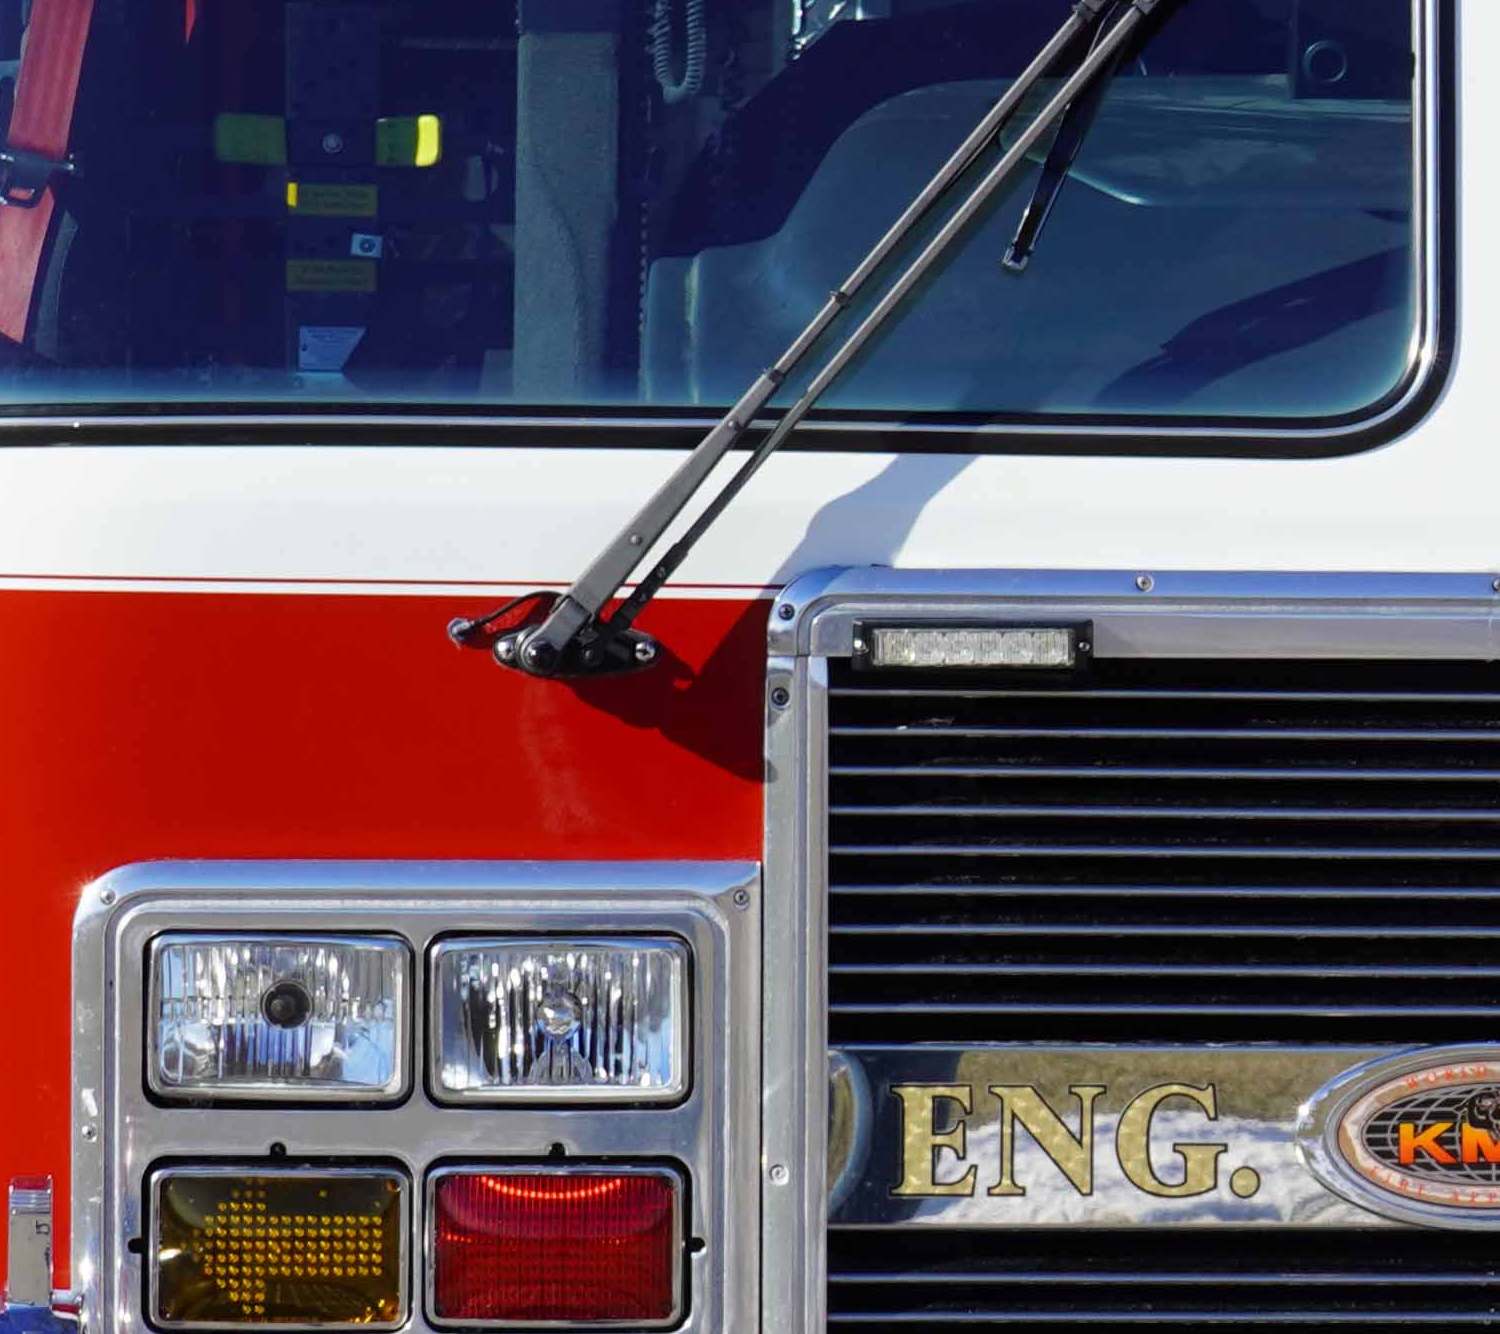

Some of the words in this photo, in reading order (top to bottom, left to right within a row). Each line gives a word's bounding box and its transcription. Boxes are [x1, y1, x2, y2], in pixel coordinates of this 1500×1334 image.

[1404, 1063, 1487, 1090] WORLD
[889, 1082, 1261, 1199] ENG.
[1369, 1165, 1426, 1195] FIRE
